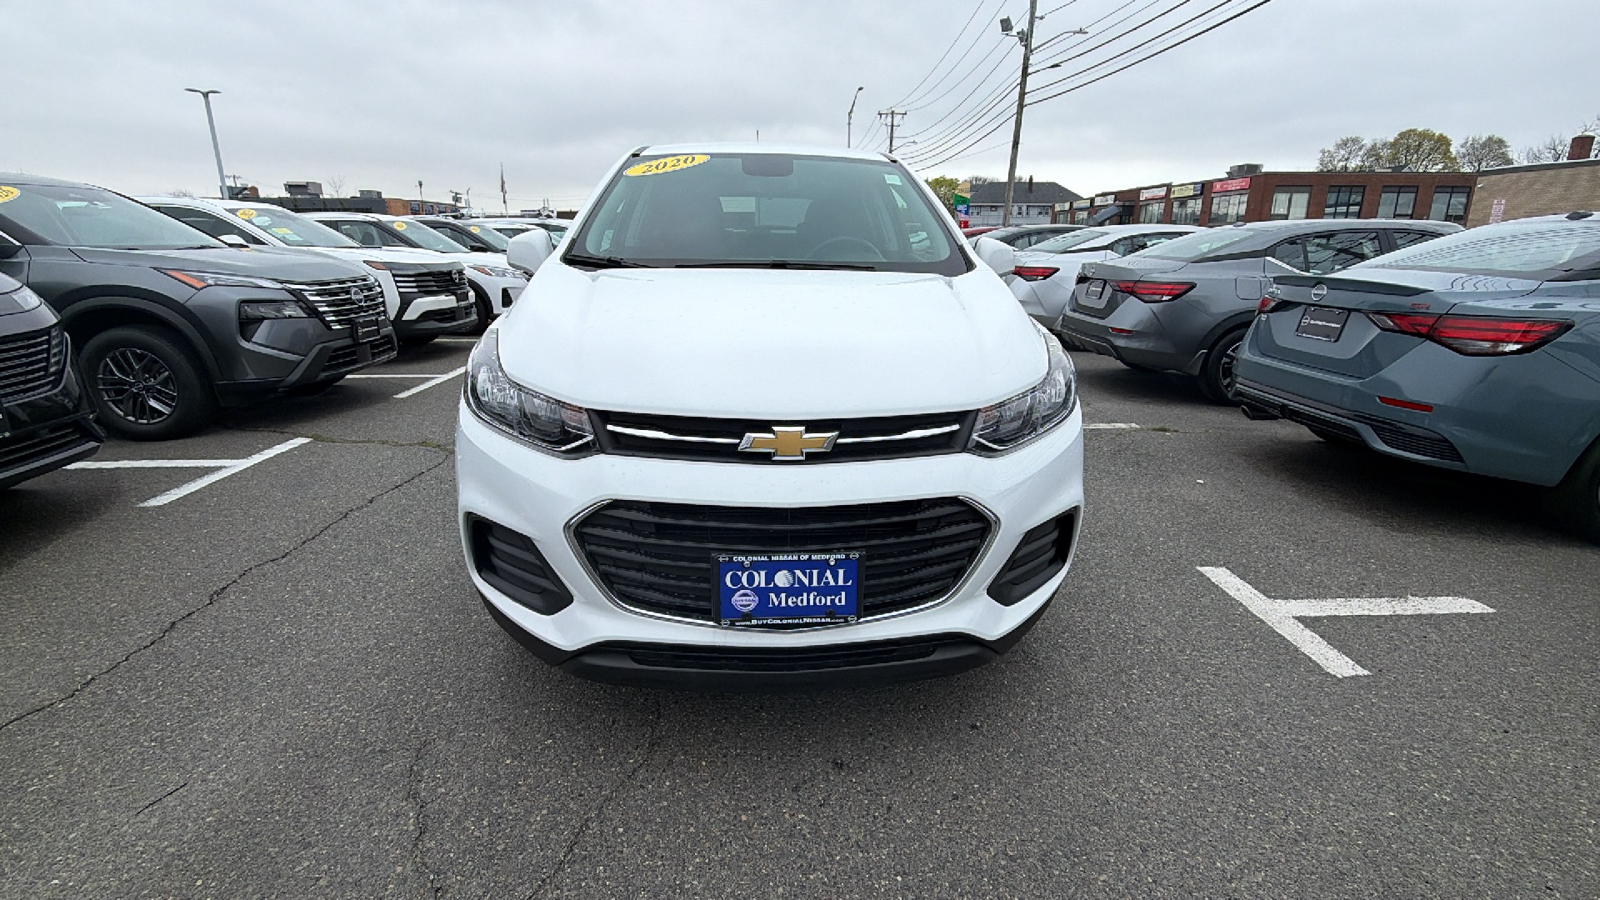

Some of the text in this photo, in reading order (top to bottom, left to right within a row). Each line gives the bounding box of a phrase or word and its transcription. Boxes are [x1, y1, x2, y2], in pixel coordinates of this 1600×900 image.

[641, 155, 696, 174] 2020
[725, 568, 853, 589] COLONIAL
[768, 591, 846, 608] Medford
